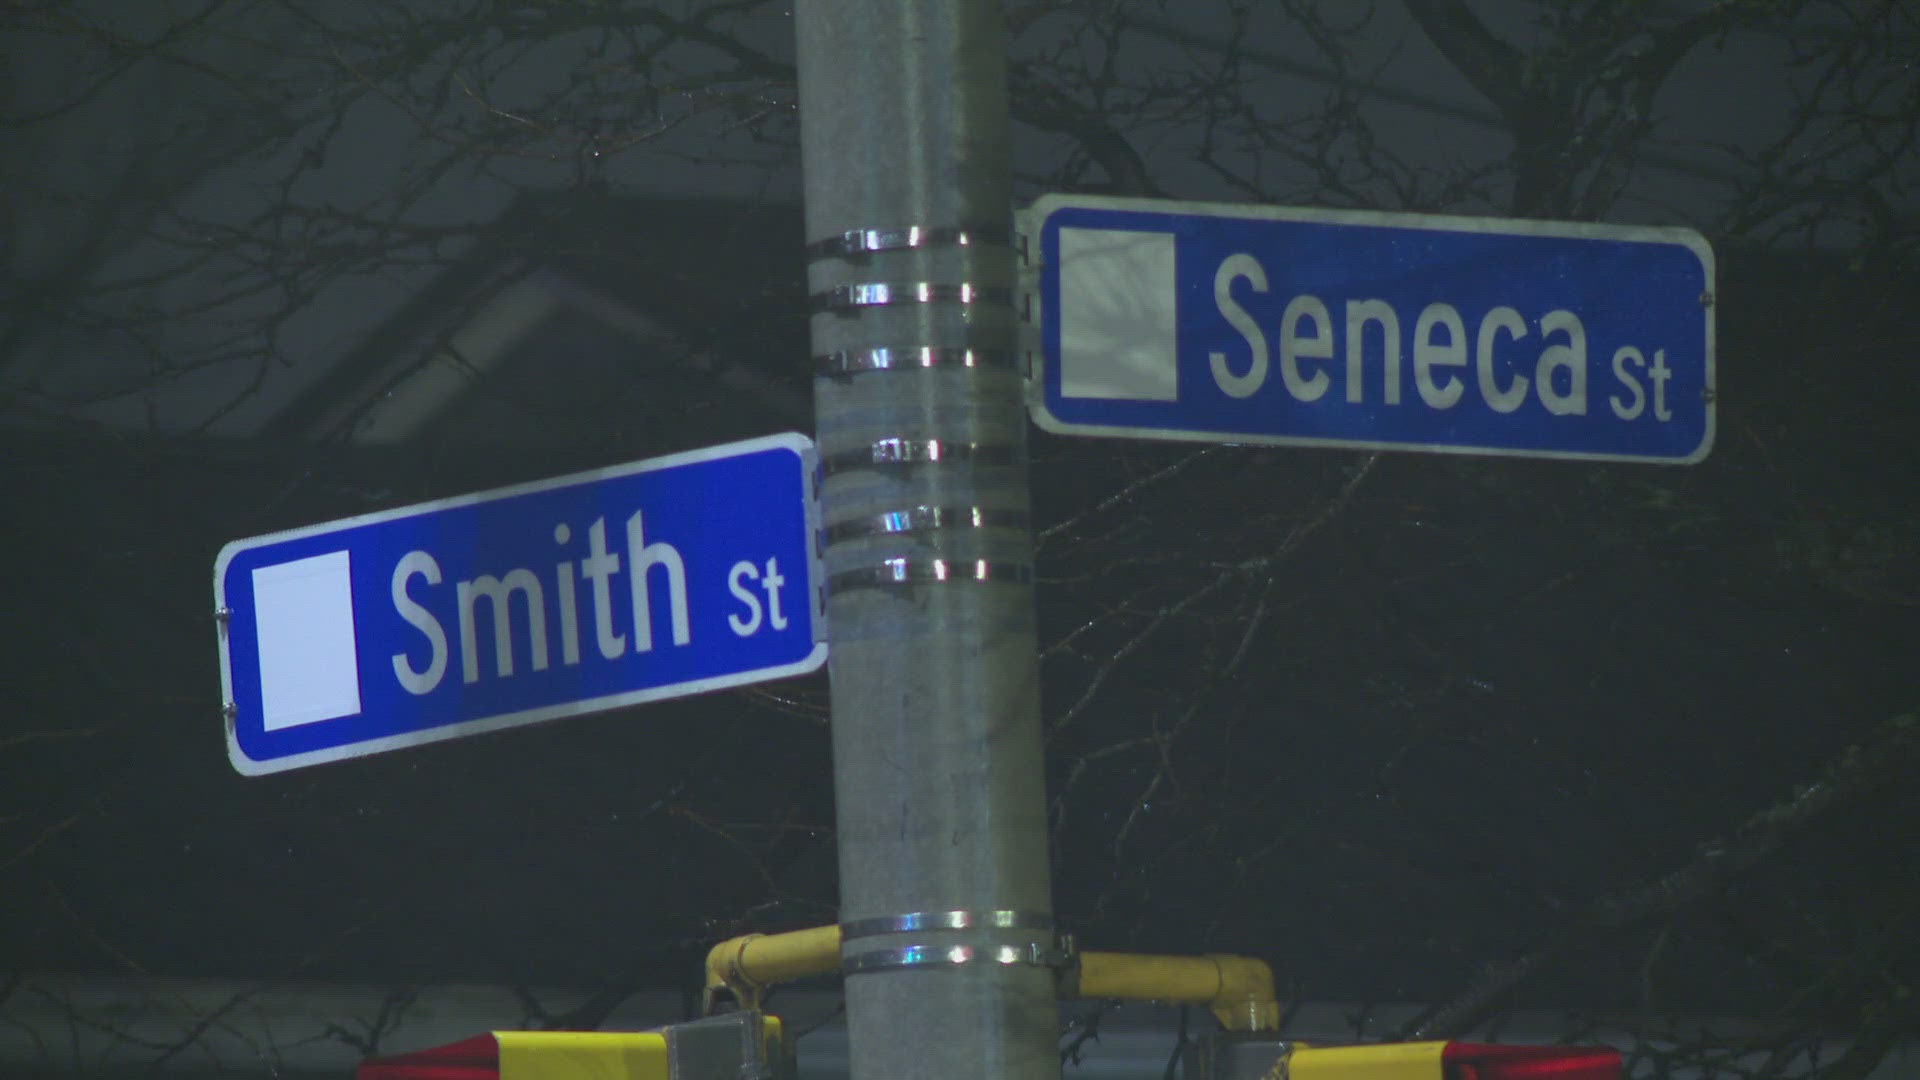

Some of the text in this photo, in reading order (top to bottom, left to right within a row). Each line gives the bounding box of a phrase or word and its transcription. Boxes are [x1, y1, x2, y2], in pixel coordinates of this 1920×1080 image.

[1209, 253, 1672, 422] Seneca St
[391, 509, 788, 696] Smith St
